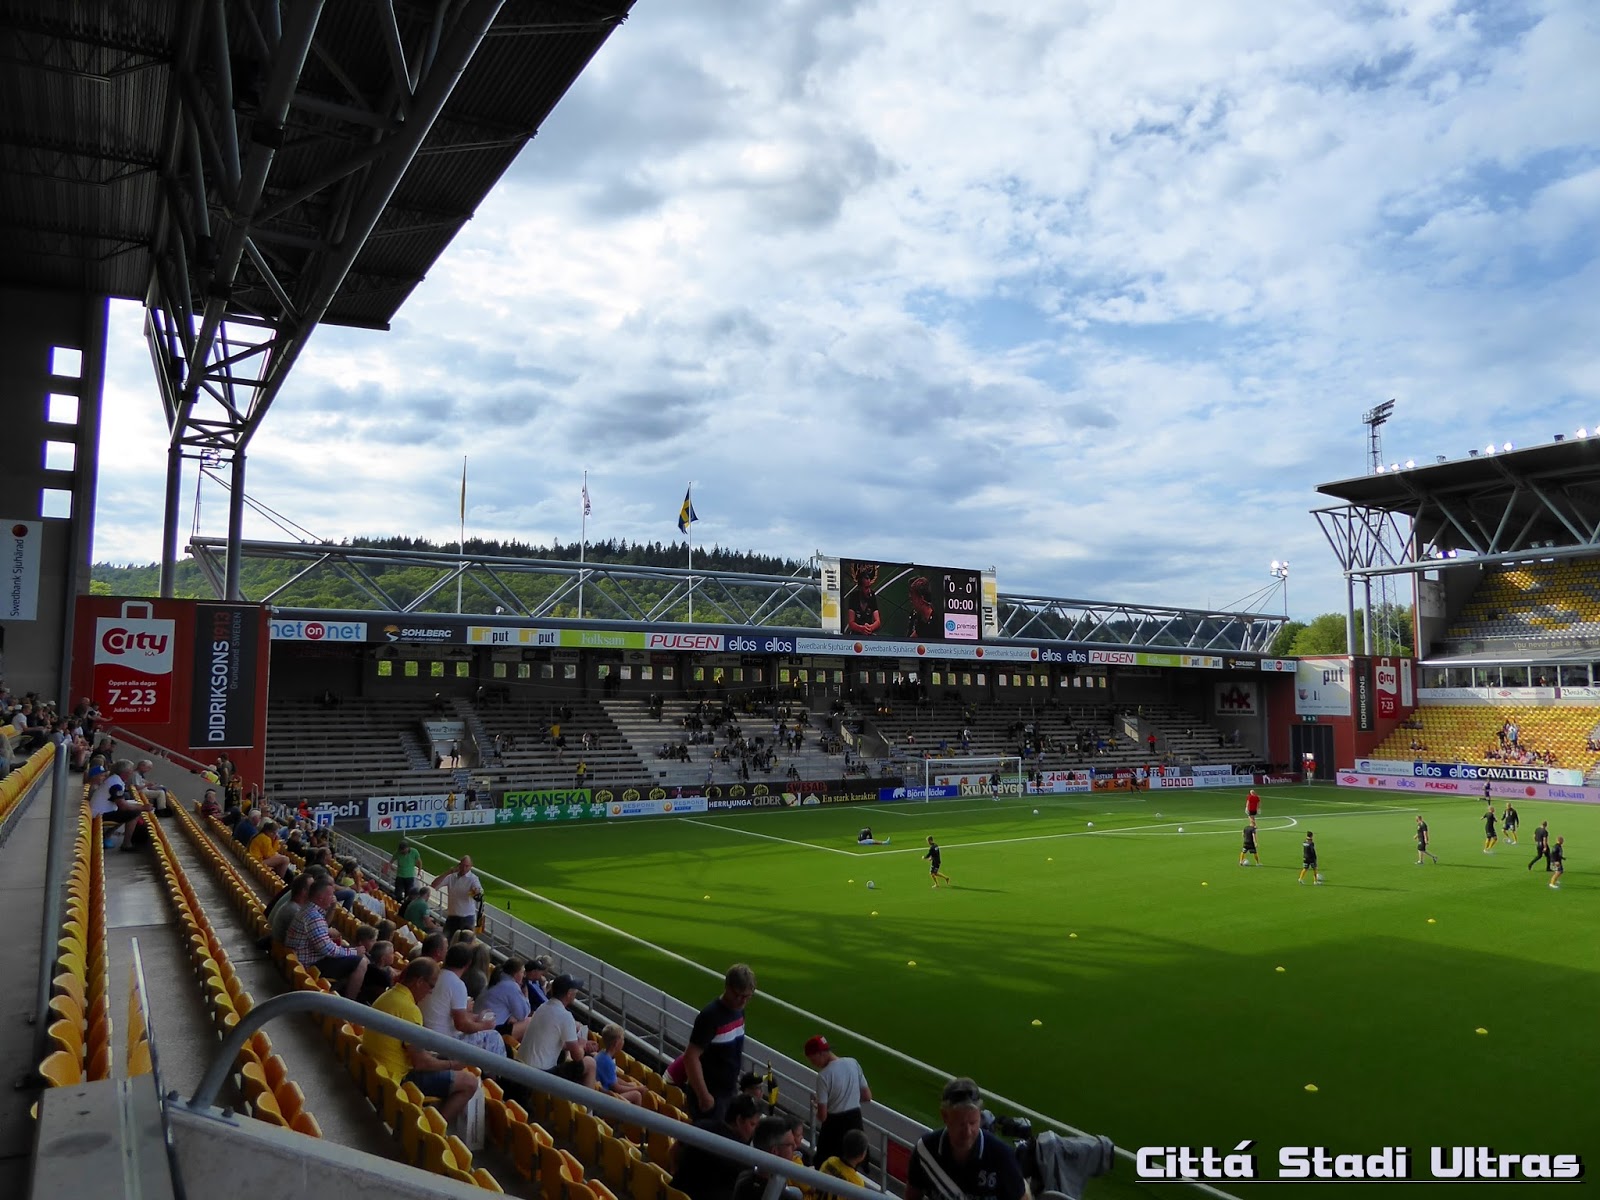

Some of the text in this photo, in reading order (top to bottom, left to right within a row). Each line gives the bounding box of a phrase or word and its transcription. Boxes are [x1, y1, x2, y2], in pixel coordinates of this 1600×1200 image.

[10, 539, 24, 617] Swedbank Sjuhärad
[825, 568, 839, 591] put
[949, 581, 955, 593] 0
[966, 583, 972, 594] 0
[948, 598, 974, 611] 00:00
[982, 606, 993, 627] put
[233, 611, 242, 646] SWEDEN
[401, 628, 452, 639] SOHLBERG
[102, 627, 169, 656] City
[492, 630, 555, 645] put put
[581, 632, 625, 646] Folksam
[649, 634, 720, 649] PULSEN
[728, 635, 793, 652] ellos ellos
[1551, 640, 1563, 649] get
[797, 641, 827, 650] Swedbank
[864, 644, 892, 652] Swedbank
[1041, 648, 1087, 663] ellos ellos
[1091, 651, 1134, 664] PULSEN
[1322, 666, 1344, 685] put
[1379, 671, 1394, 685] City
[108, 688, 158, 705] 7-23
[208, 640, 230, 742] DIDRIKSONS
[1359, 675, 1367, 729] DIDRIKSONS
[1380, 701, 1394, 710] 7-23
[1414, 764, 1477, 780] ellos ellos
[1477, 767, 1546, 781] CAVALIERE
[1424, 781, 1458, 790] PULSEN
[506, 791, 587, 809] SKANSKA
[822, 792, 877, 803] En stark karaktär
[1548, 788, 1585, 799] Folksam
[709, 795, 782, 809] HERRLJUNGA CIDER
[393, 813, 432, 829] TIPS
